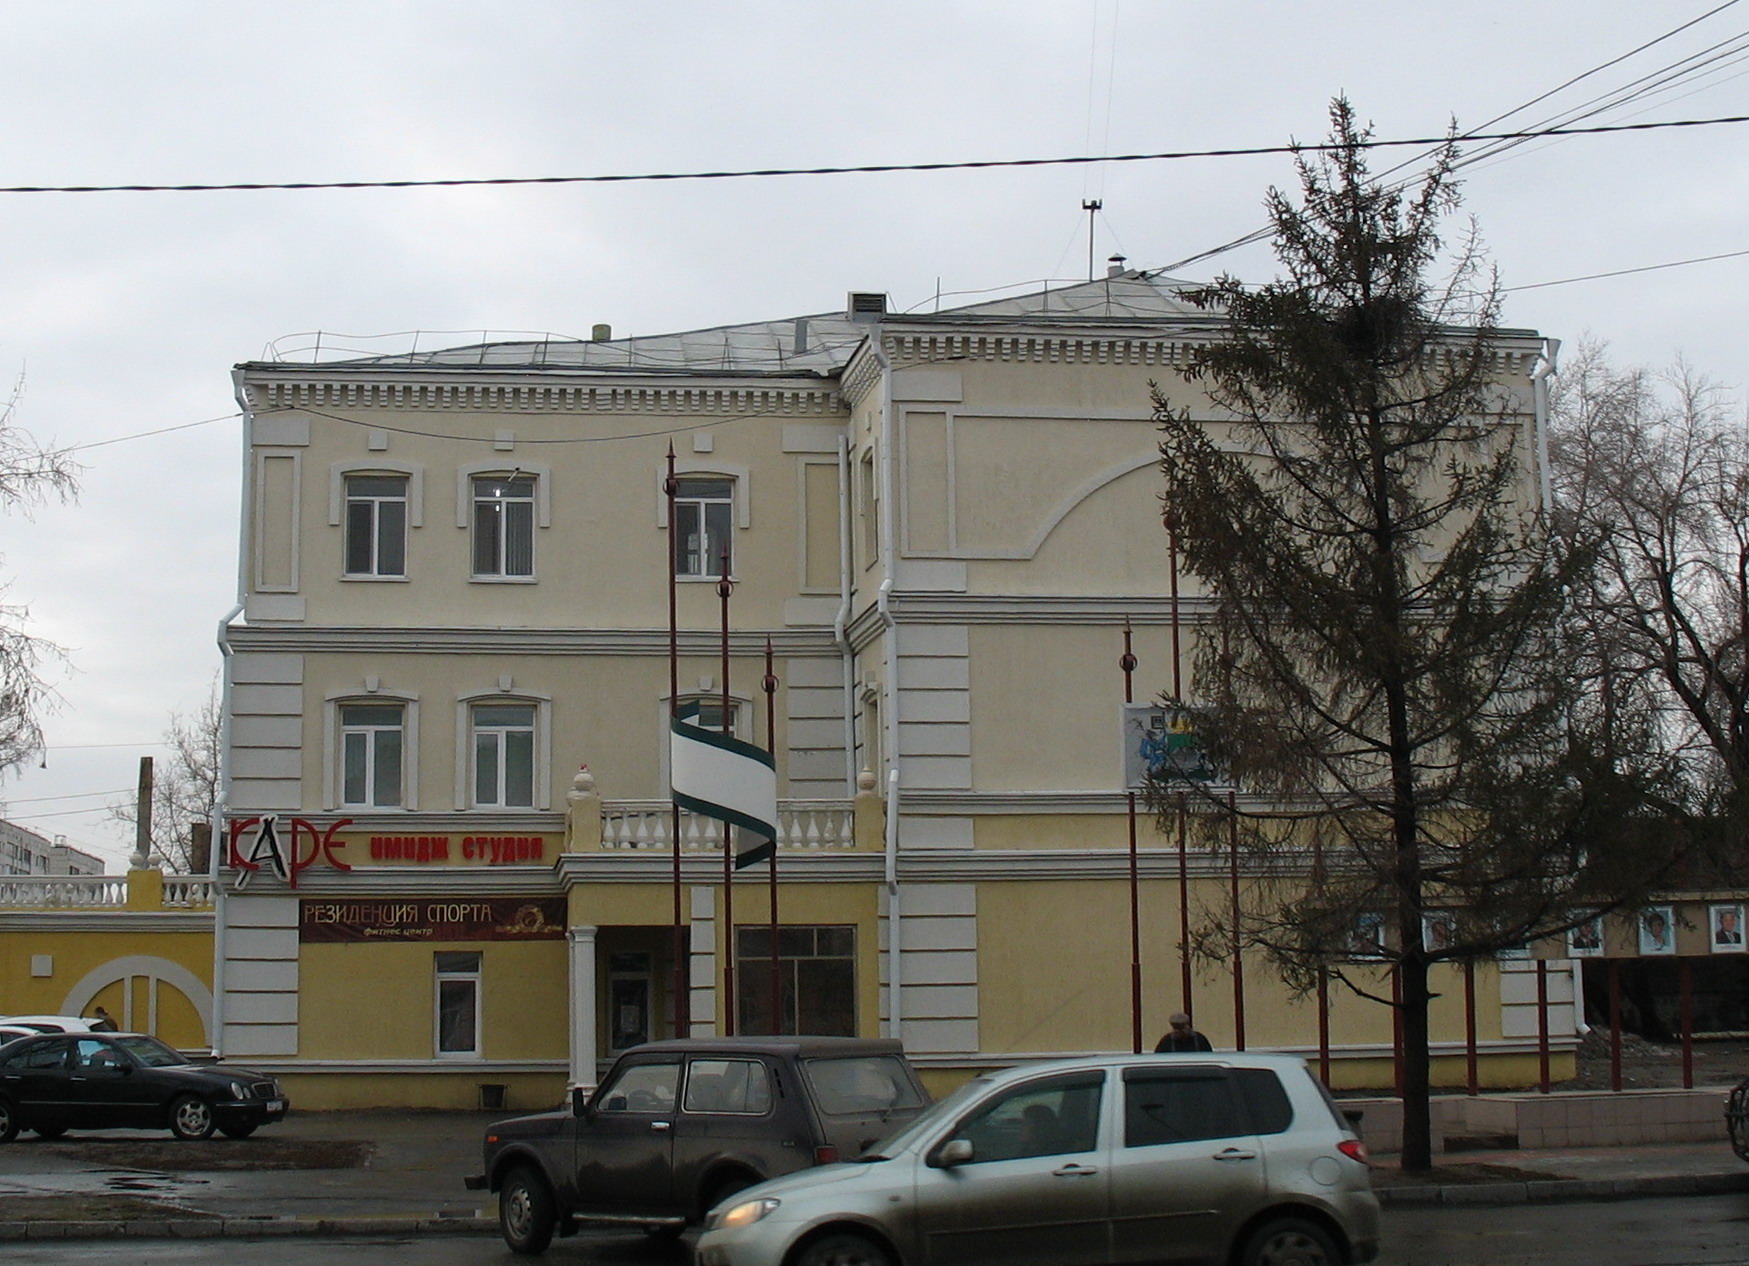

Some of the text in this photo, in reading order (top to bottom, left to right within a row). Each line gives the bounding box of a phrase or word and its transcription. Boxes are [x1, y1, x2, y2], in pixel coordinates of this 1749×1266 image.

[229, 815, 353, 889] КАРЕ
[304, 904, 492, 927] РЕЗИДЕНЦИЯ СПОРТА
